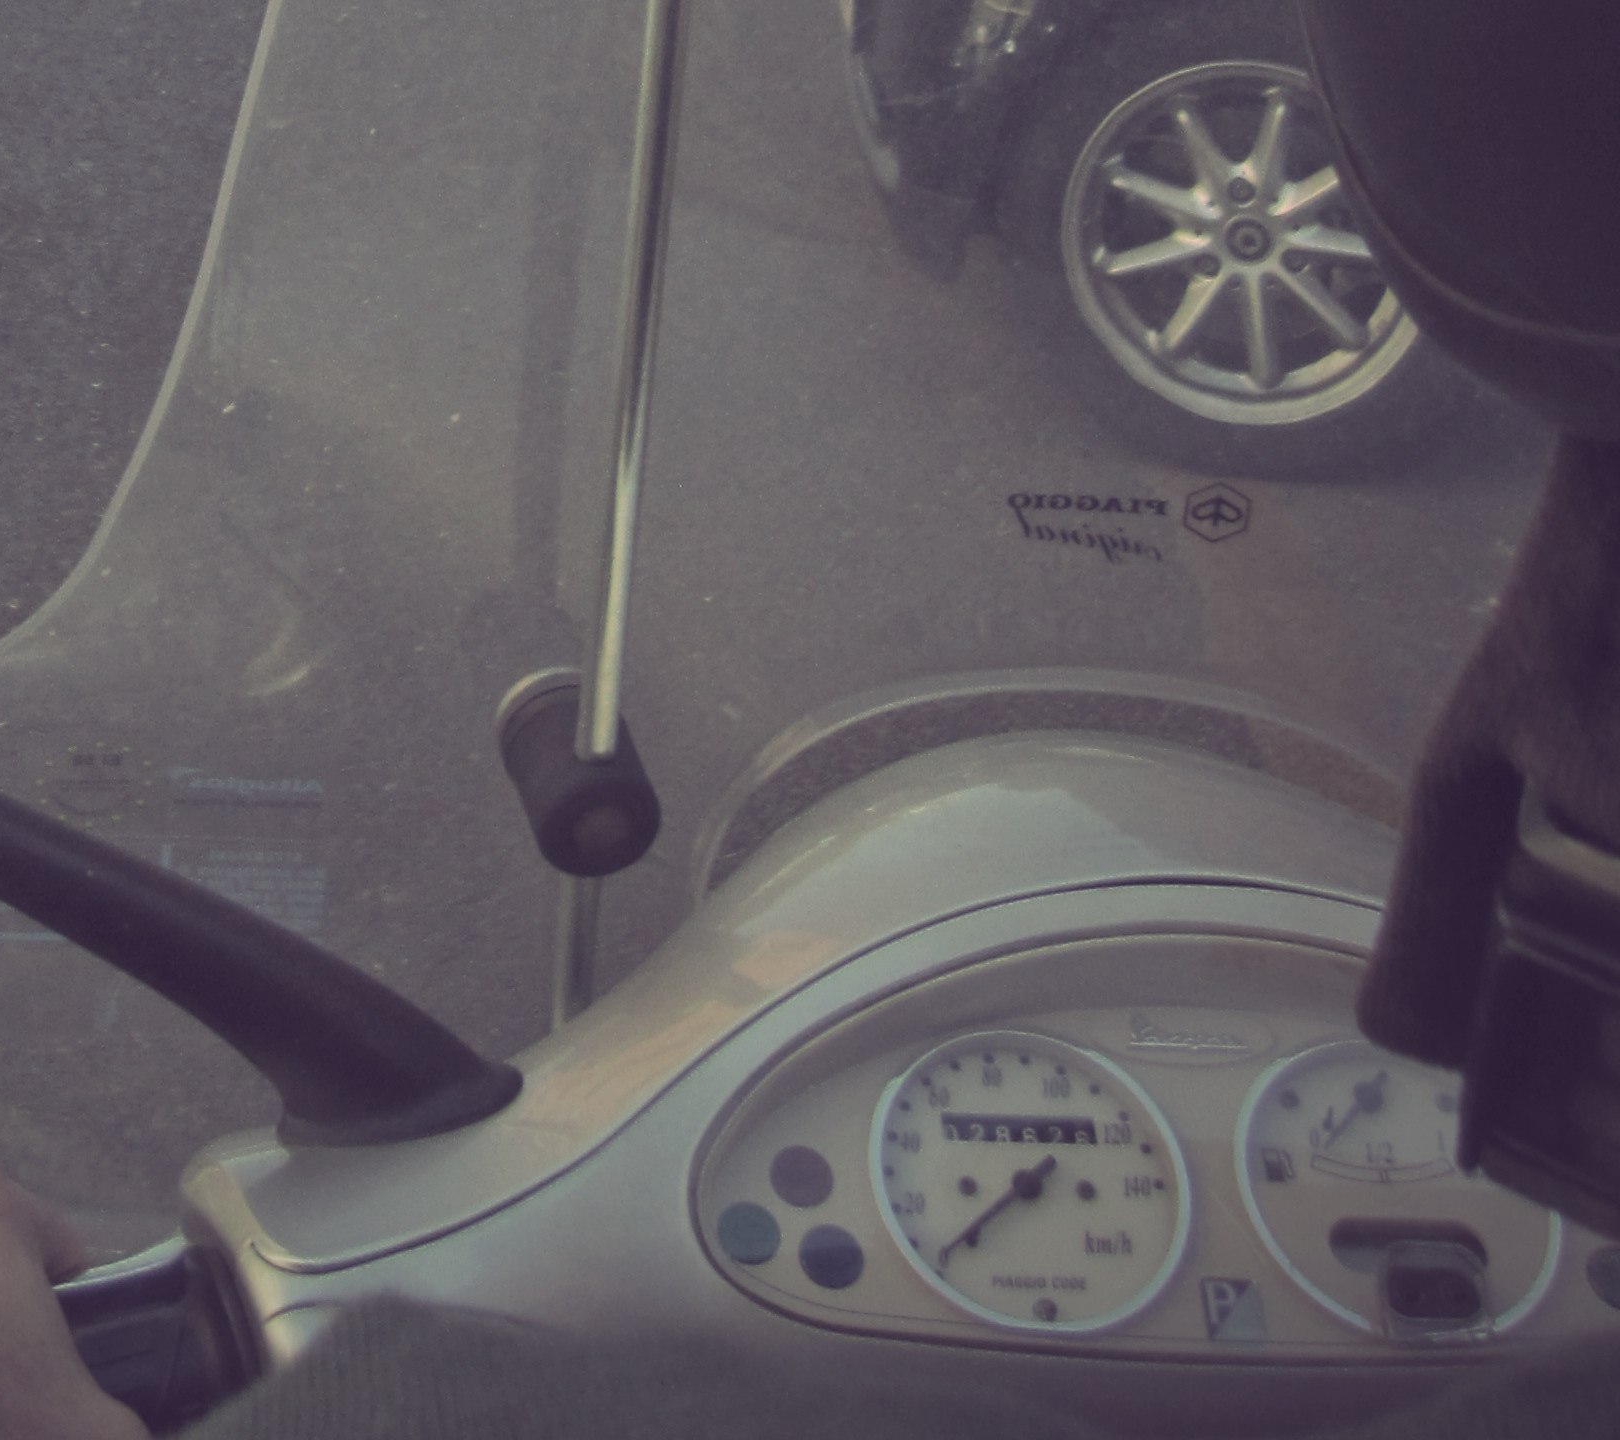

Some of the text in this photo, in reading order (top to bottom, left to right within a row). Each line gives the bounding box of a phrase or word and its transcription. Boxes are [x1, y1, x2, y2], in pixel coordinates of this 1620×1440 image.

[928, 1085, 951, 1109] 60
[1042, 1077, 1072, 1098] 100
[898, 1131, 921, 1154] 40
[1103, 1123, 1133, 1146] 120
[1123, 1176, 1153, 1198] 140
[902, 1192, 926, 1215] 20
[1084, 1229, 1134, 1255] km/h
[991, 1275, 1088, 1290] PIAGGIO CODE
[1205, 1280, 1237, 1324] P
